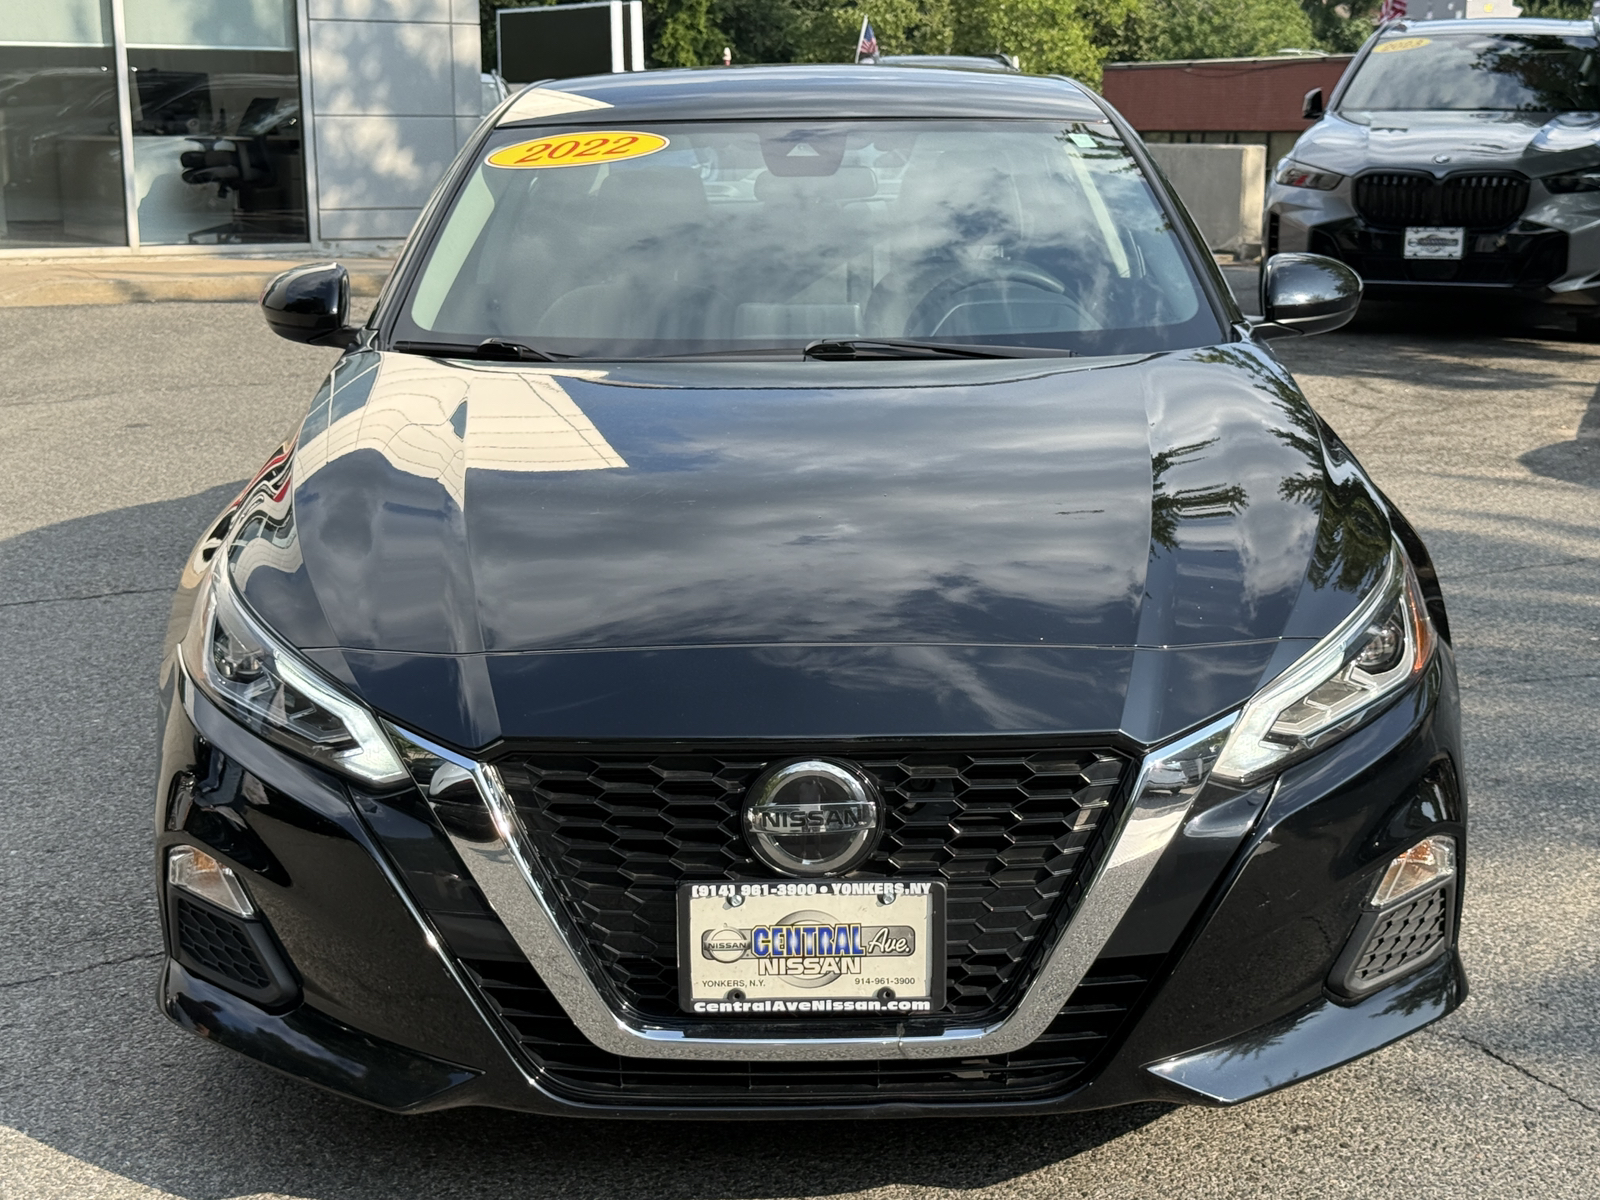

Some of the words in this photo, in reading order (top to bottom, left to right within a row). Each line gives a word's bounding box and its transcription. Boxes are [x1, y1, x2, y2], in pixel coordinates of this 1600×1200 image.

[513, 136, 639, 164] 2022
[762, 808, 861, 828] NISSAN
[741, 883, 816, 897] 961-3900
[707, 941, 747, 949] NISSAN
[751, 923, 866, 957] CENTRAL
[868, 926, 911, 954] Ave.
[758, 956, 862, 976] NISSAN
[702, 979, 747, 988] YONKERS,
[749, 979, 766, 987] N.Y.
[854, 977, 916, 985] 914-961-3900
[693, 1000, 931, 1012] CentralAveNissan.com
